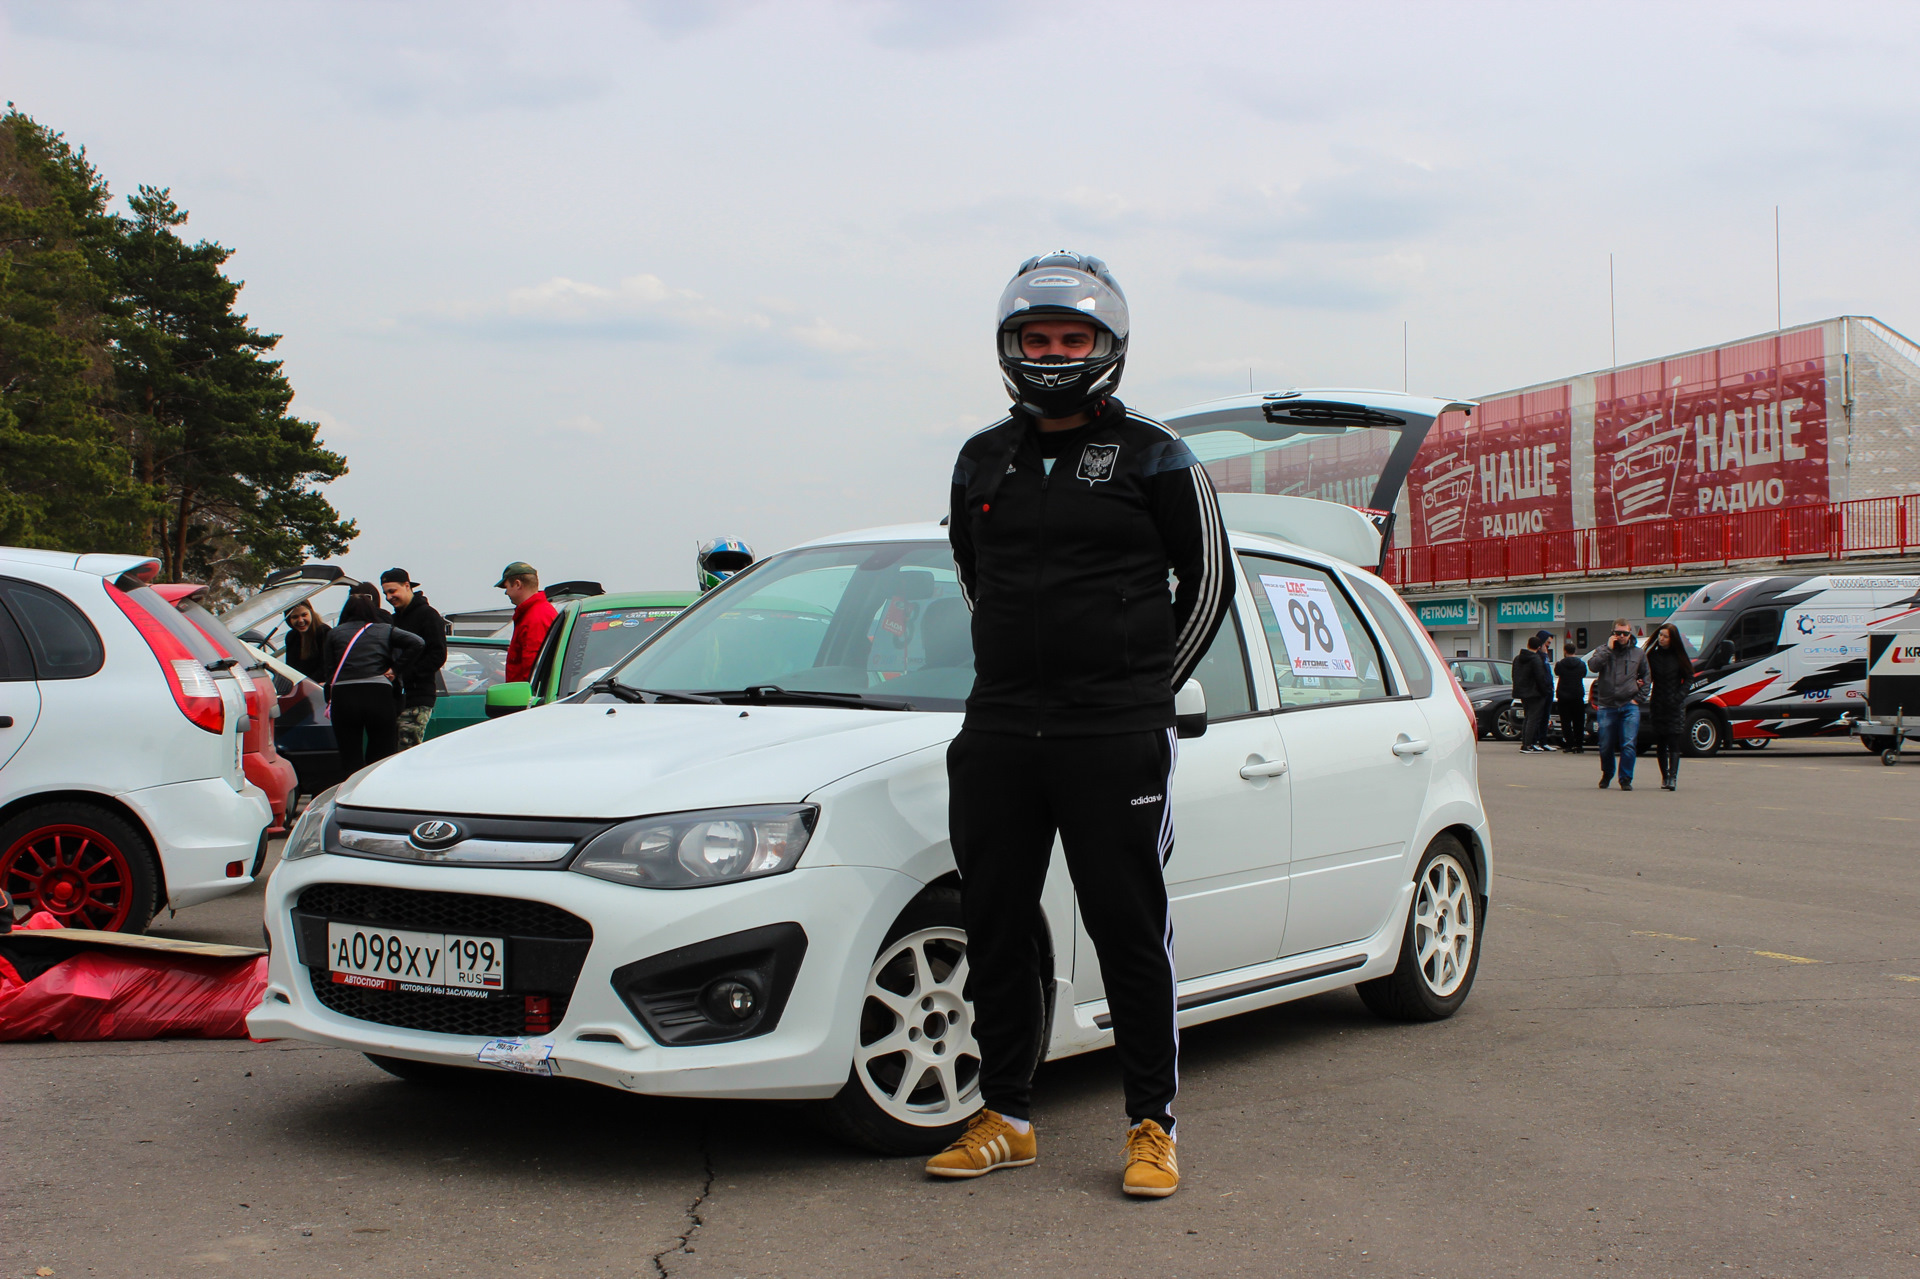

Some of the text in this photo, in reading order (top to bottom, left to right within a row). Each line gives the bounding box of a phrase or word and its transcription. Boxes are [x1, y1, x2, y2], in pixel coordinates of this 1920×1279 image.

[1695, 397, 1806, 474] НАШЕ
[1480, 442, 1557, 504] НАШЕ
[1698, 478, 1784, 515] РАДИО
[1482, 508, 1543, 540] РАДИО
[1829, 577, 1920, 588] www.kramar-mo
[1500, 600, 1550, 616] PETRONAS
[1651, 592, 1692, 609] PETRO
[1420, 604, 1464, 620] PETRONAS
[1816, 614, 1866, 624] ОВЕРХОЛ-ПРО
[885, 619, 903, 632] LADA
[1288, 598, 1333, 654] 98
[1803, 688, 1831, 700] IGOL
[1130, 794, 1157, 806] adidas
[337, 931, 495, 978] А098ХУ 199
[344, 973, 489, 999] АВТОСПОРТ КОТОРЫЙ МЫ ЗАСЛУЖИЛИ
[458, 972, 482, 984] RUS
